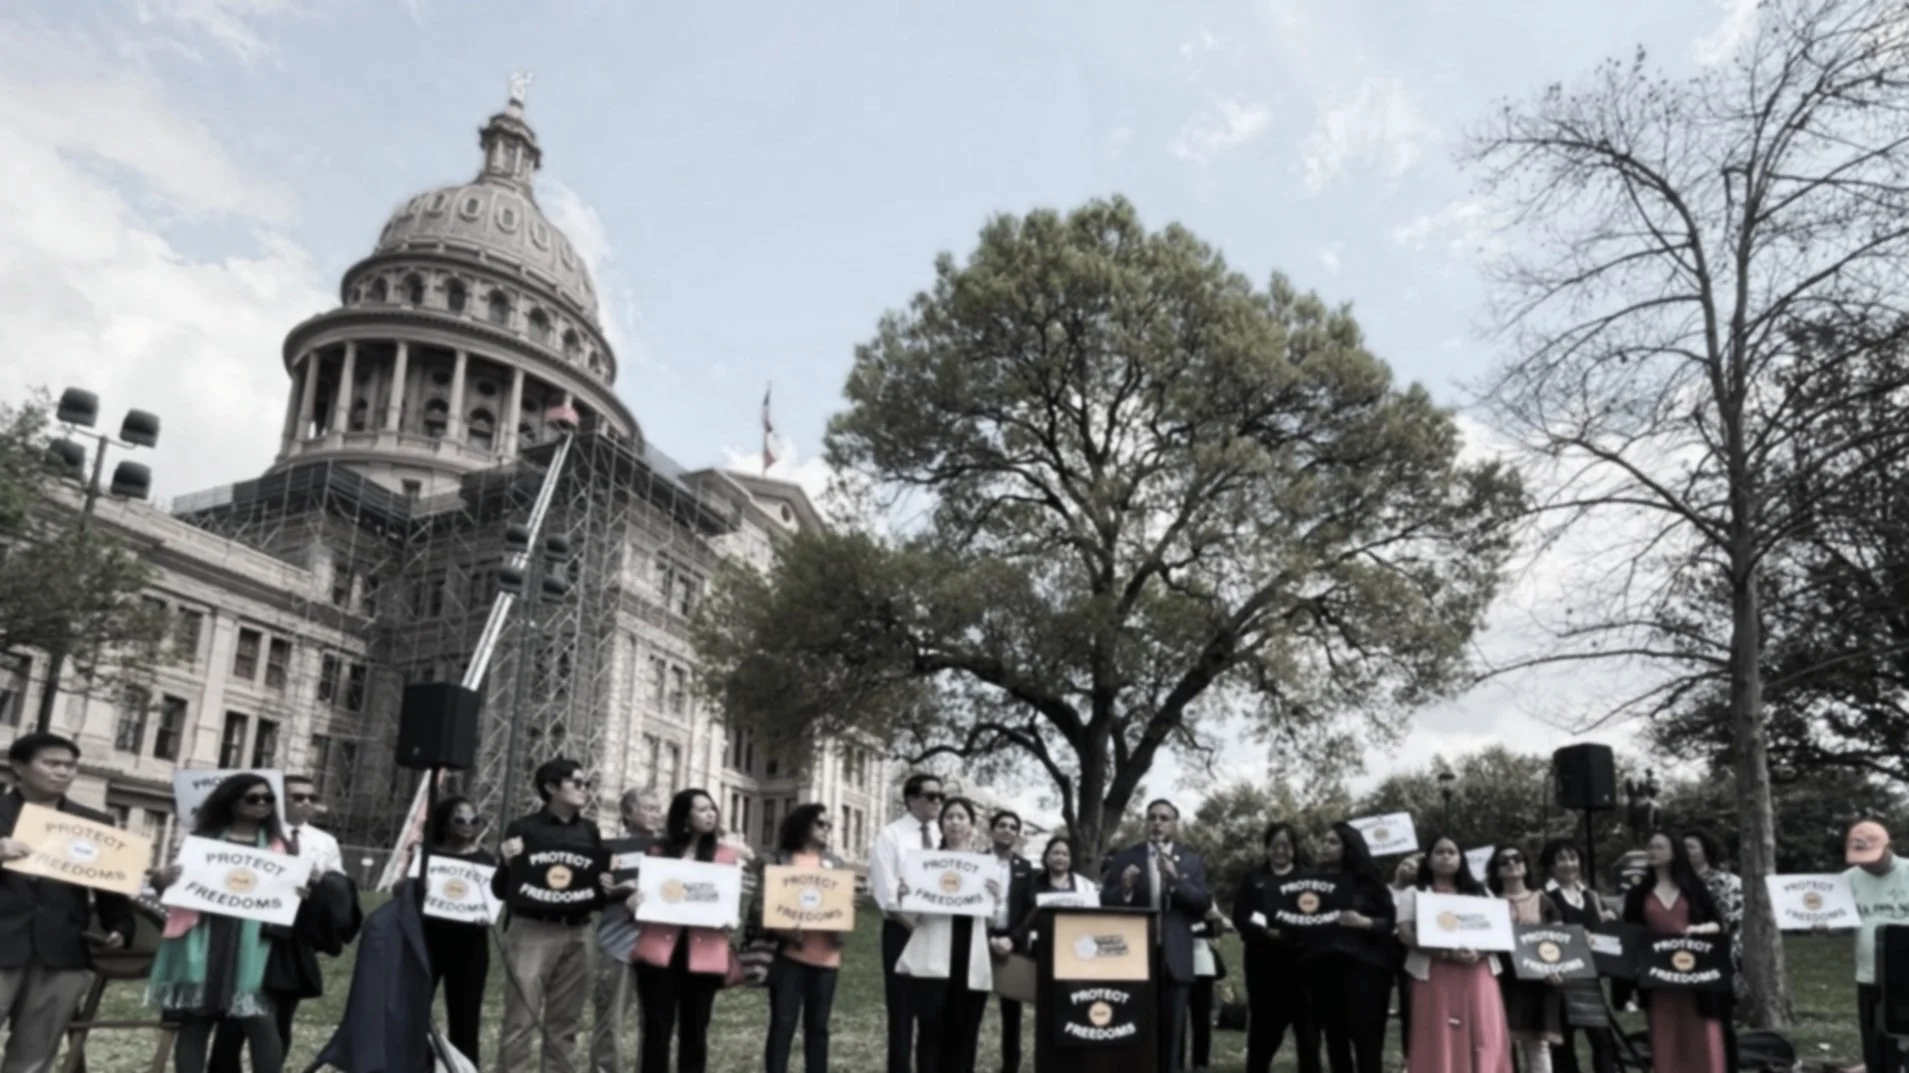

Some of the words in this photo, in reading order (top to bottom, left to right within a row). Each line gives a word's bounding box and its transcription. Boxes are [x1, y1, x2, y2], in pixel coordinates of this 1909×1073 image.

[45, 822, 127, 852] PROTECT
[36, 853, 126, 880] REEDOMS
[205, 852, 286, 876] PROTECT
[529, 851, 593, 869] PROTECT
[922, 858, 980, 874] PROTECT
[782, 875, 839, 891] PROTECT
[1280, 879, 1336, 895] PROTECT
[1783, 881, 1834, 893] PROTECT
[184, 880, 283, 909] FREEDOMS
[519, 882, 595, 903] FREEDOMS
[915, 887, 984, 907] FREEDOMS
[776, 904, 843, 922] FREEDOMS
[1785, 908, 1847, 921] FREEDOMS
[1652, 938, 1714, 954] PROTECT
[1648, 966, 1722, 984] FREEDOMS
[1070, 988, 1130, 1005] PROTECT
[1064, 1021, 1136, 1040] FREEDOMS
